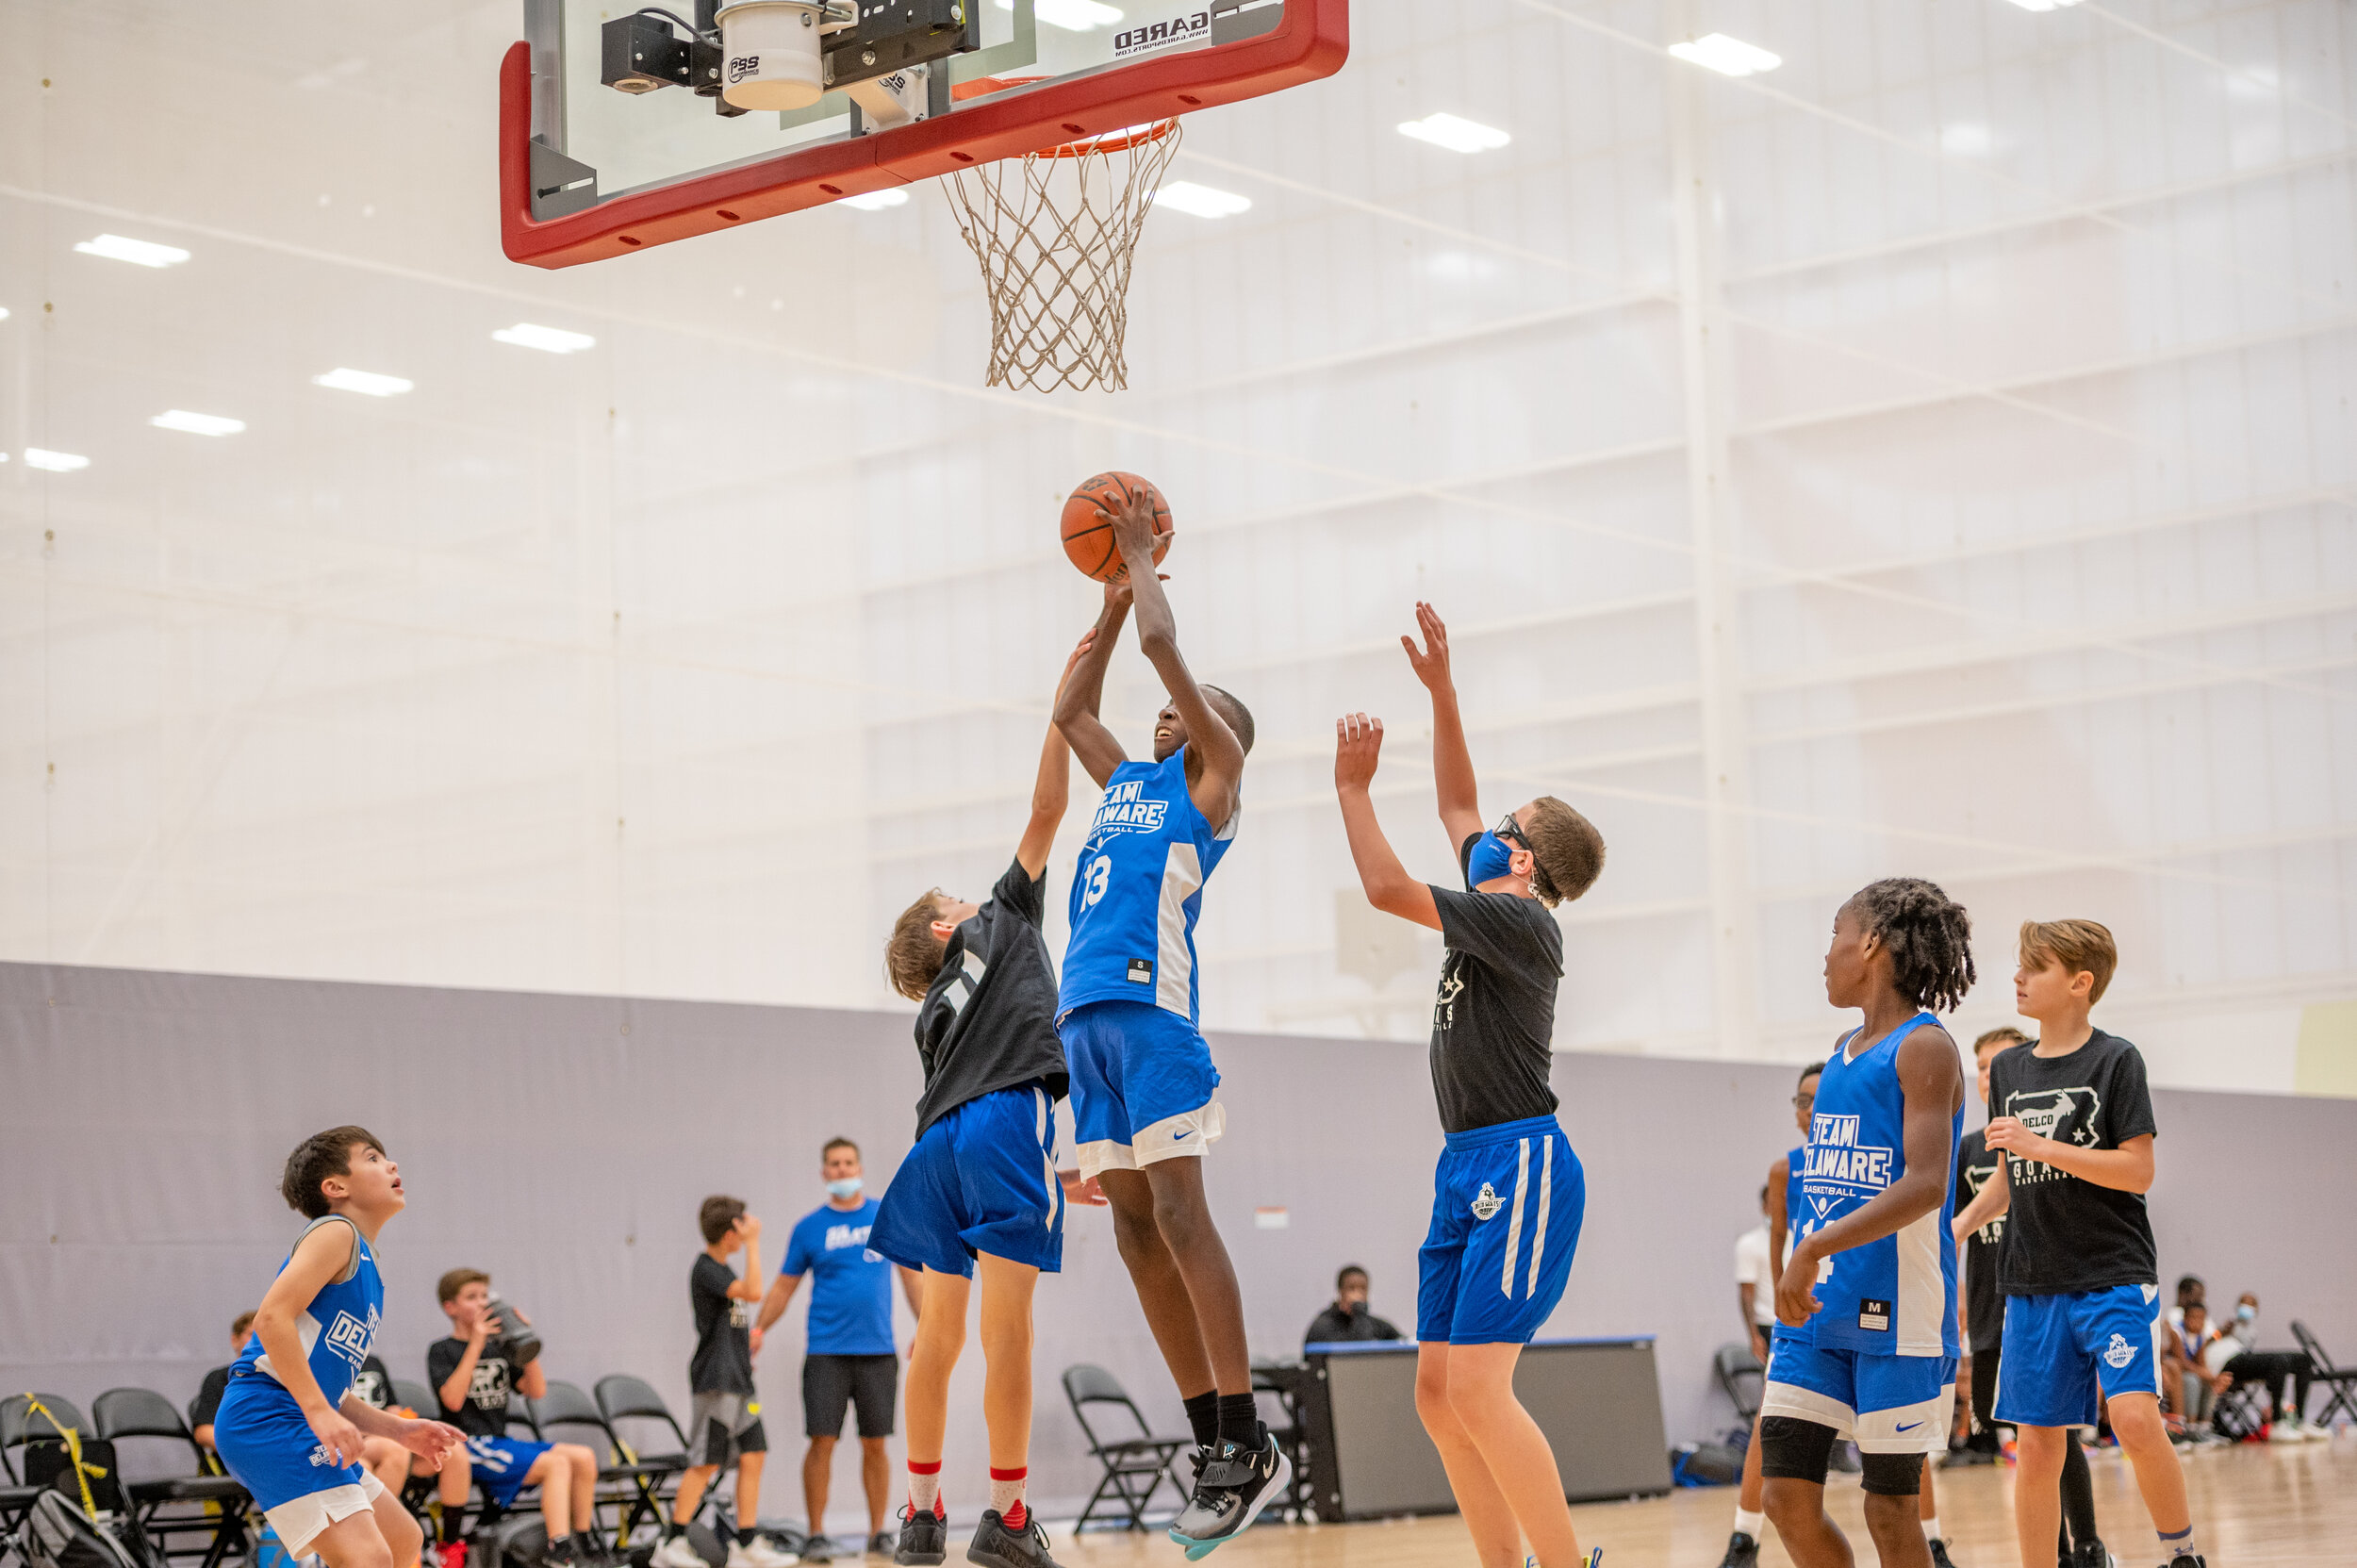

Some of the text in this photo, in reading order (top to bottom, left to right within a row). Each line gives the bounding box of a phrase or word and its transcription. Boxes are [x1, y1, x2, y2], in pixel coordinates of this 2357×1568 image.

[731, 57, 759, 74] PSS
[1099, 784, 1139, 808] EAM
[1094, 803, 1163, 828] AWARE
[1080, 854, 1112, 913] 13
[1137, 961, 1144, 969] S
[2022, 1115, 2053, 1129] DELCO
[1814, 1116, 1855, 1147] TEAM
[1804, 1148, 1887, 1185] ELAWARE
[2014, 1161, 2051, 1179] GOA
[1803, 1185, 1856, 1197] BASKETBALL
[1868, 1302, 1881, 1312] M
